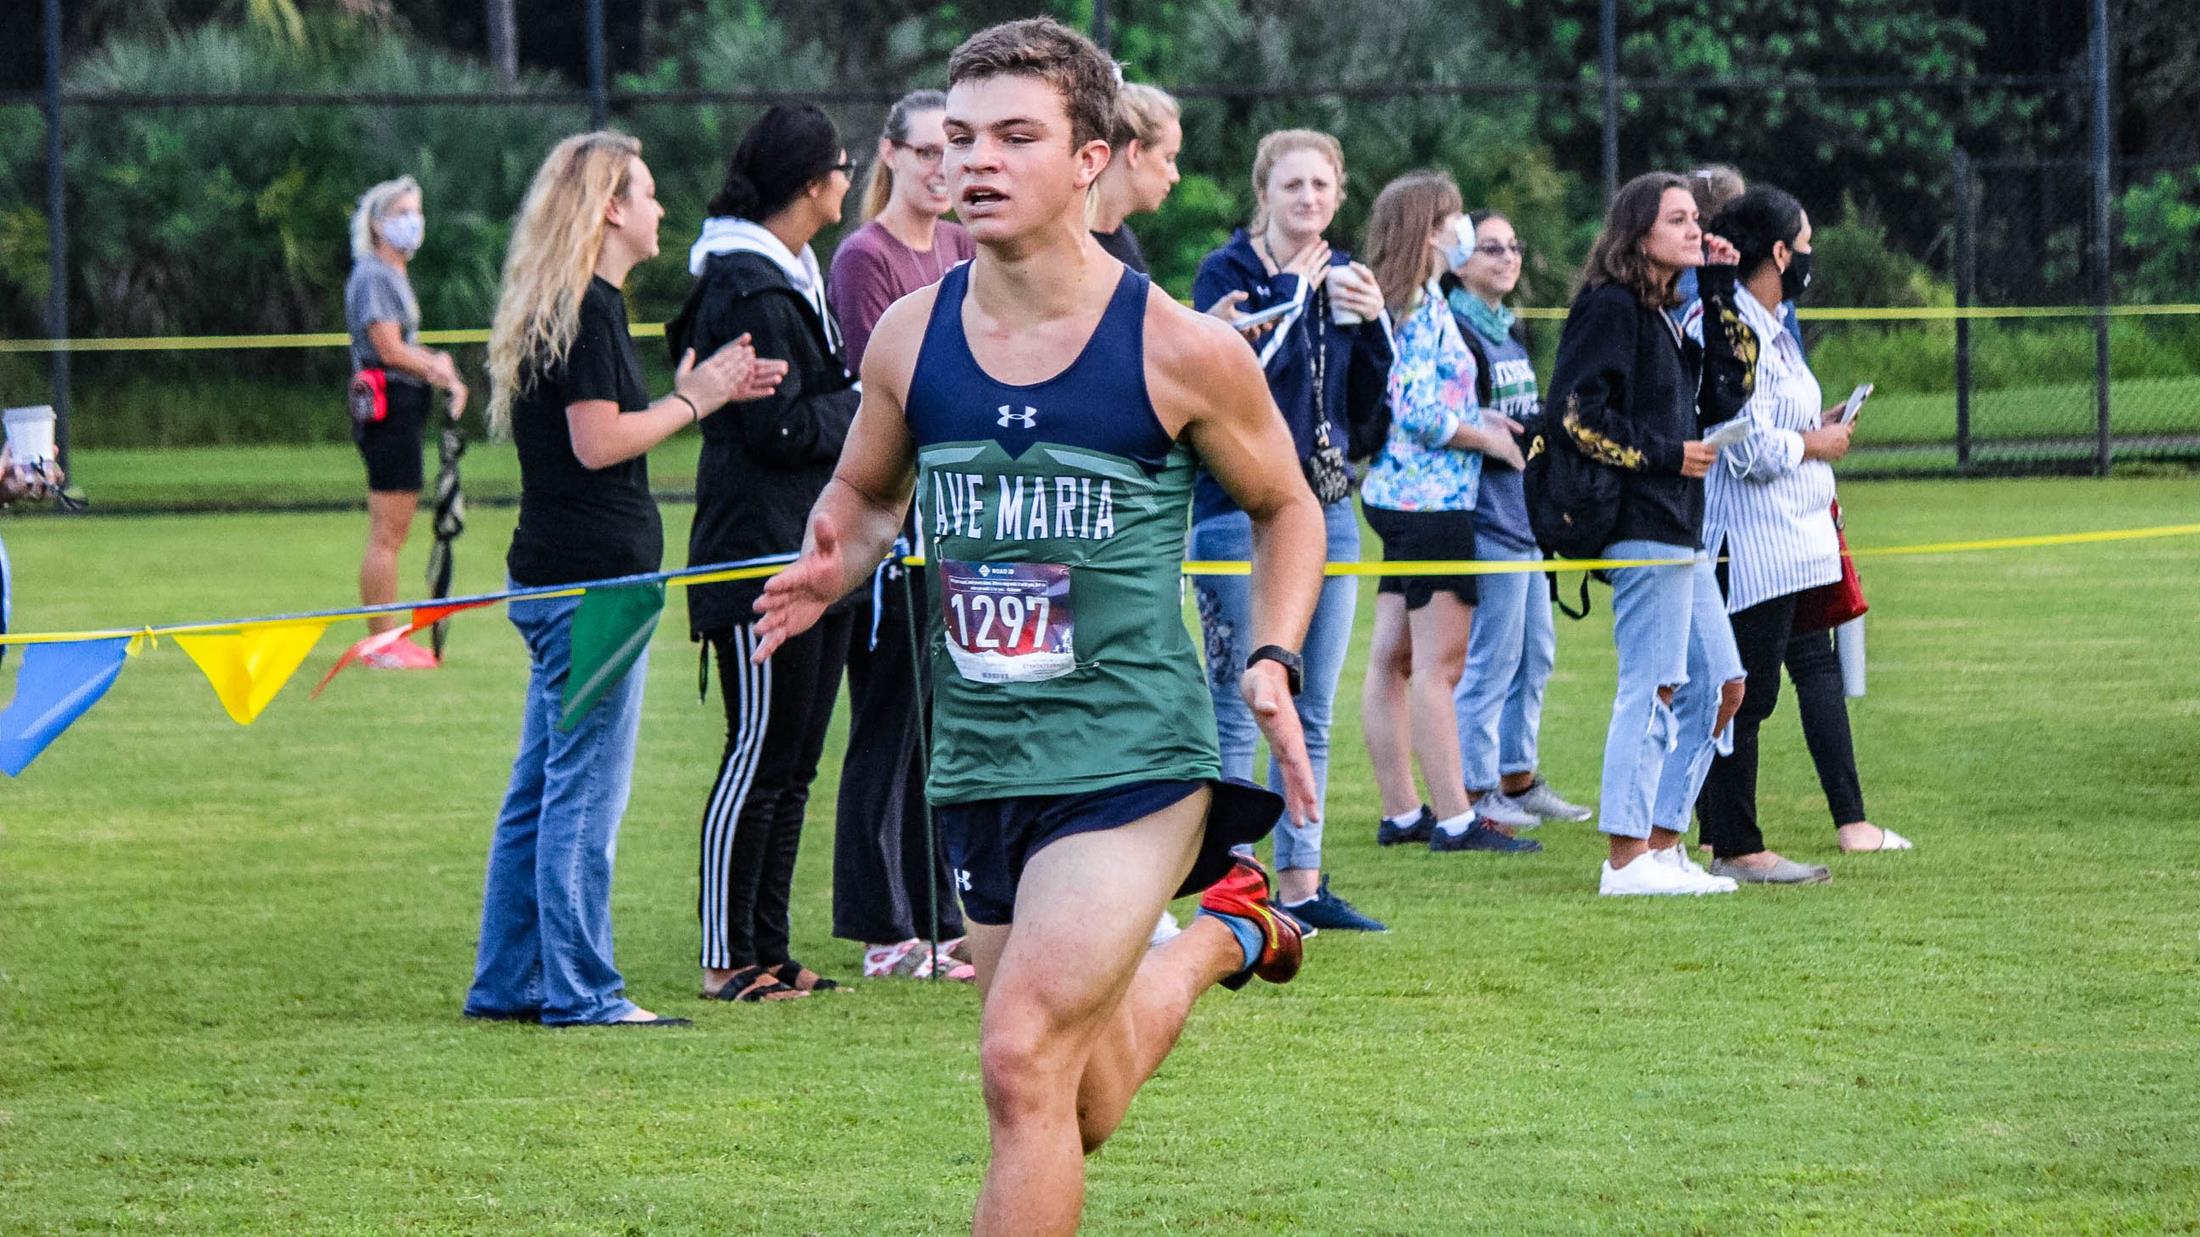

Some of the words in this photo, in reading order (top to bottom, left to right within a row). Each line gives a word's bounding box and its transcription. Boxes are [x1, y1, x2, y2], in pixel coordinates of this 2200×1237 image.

[933, 471, 984, 539] AVE
[995, 474, 1115, 541] MARIA
[950, 593, 1050, 648] 1297
